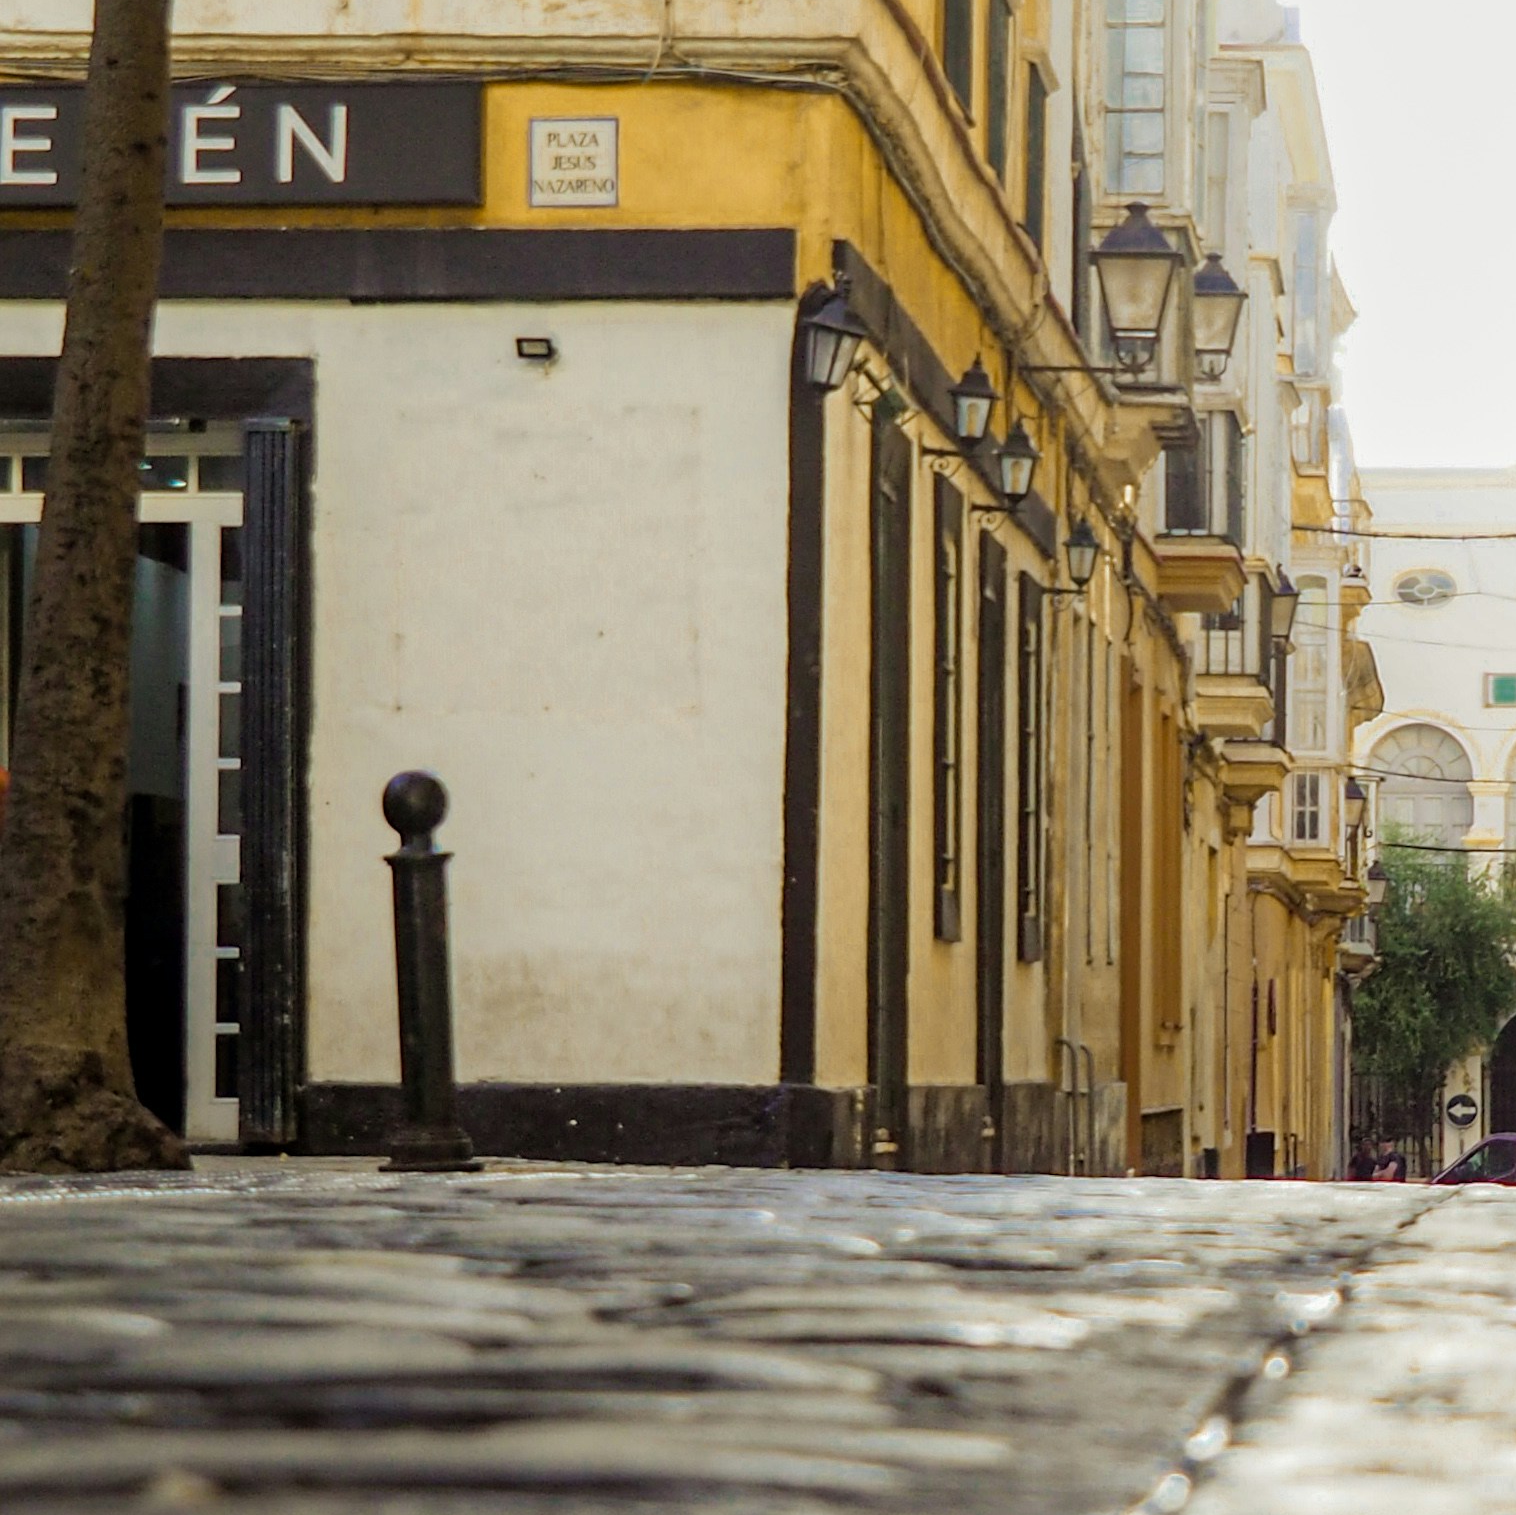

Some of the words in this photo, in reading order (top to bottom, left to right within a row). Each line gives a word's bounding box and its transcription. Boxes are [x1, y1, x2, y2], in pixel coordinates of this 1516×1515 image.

[0, 85, 349, 184] EÉN
[546, 132, 600, 148] PLAZA
[534, 178, 615, 194] NAZARENO
